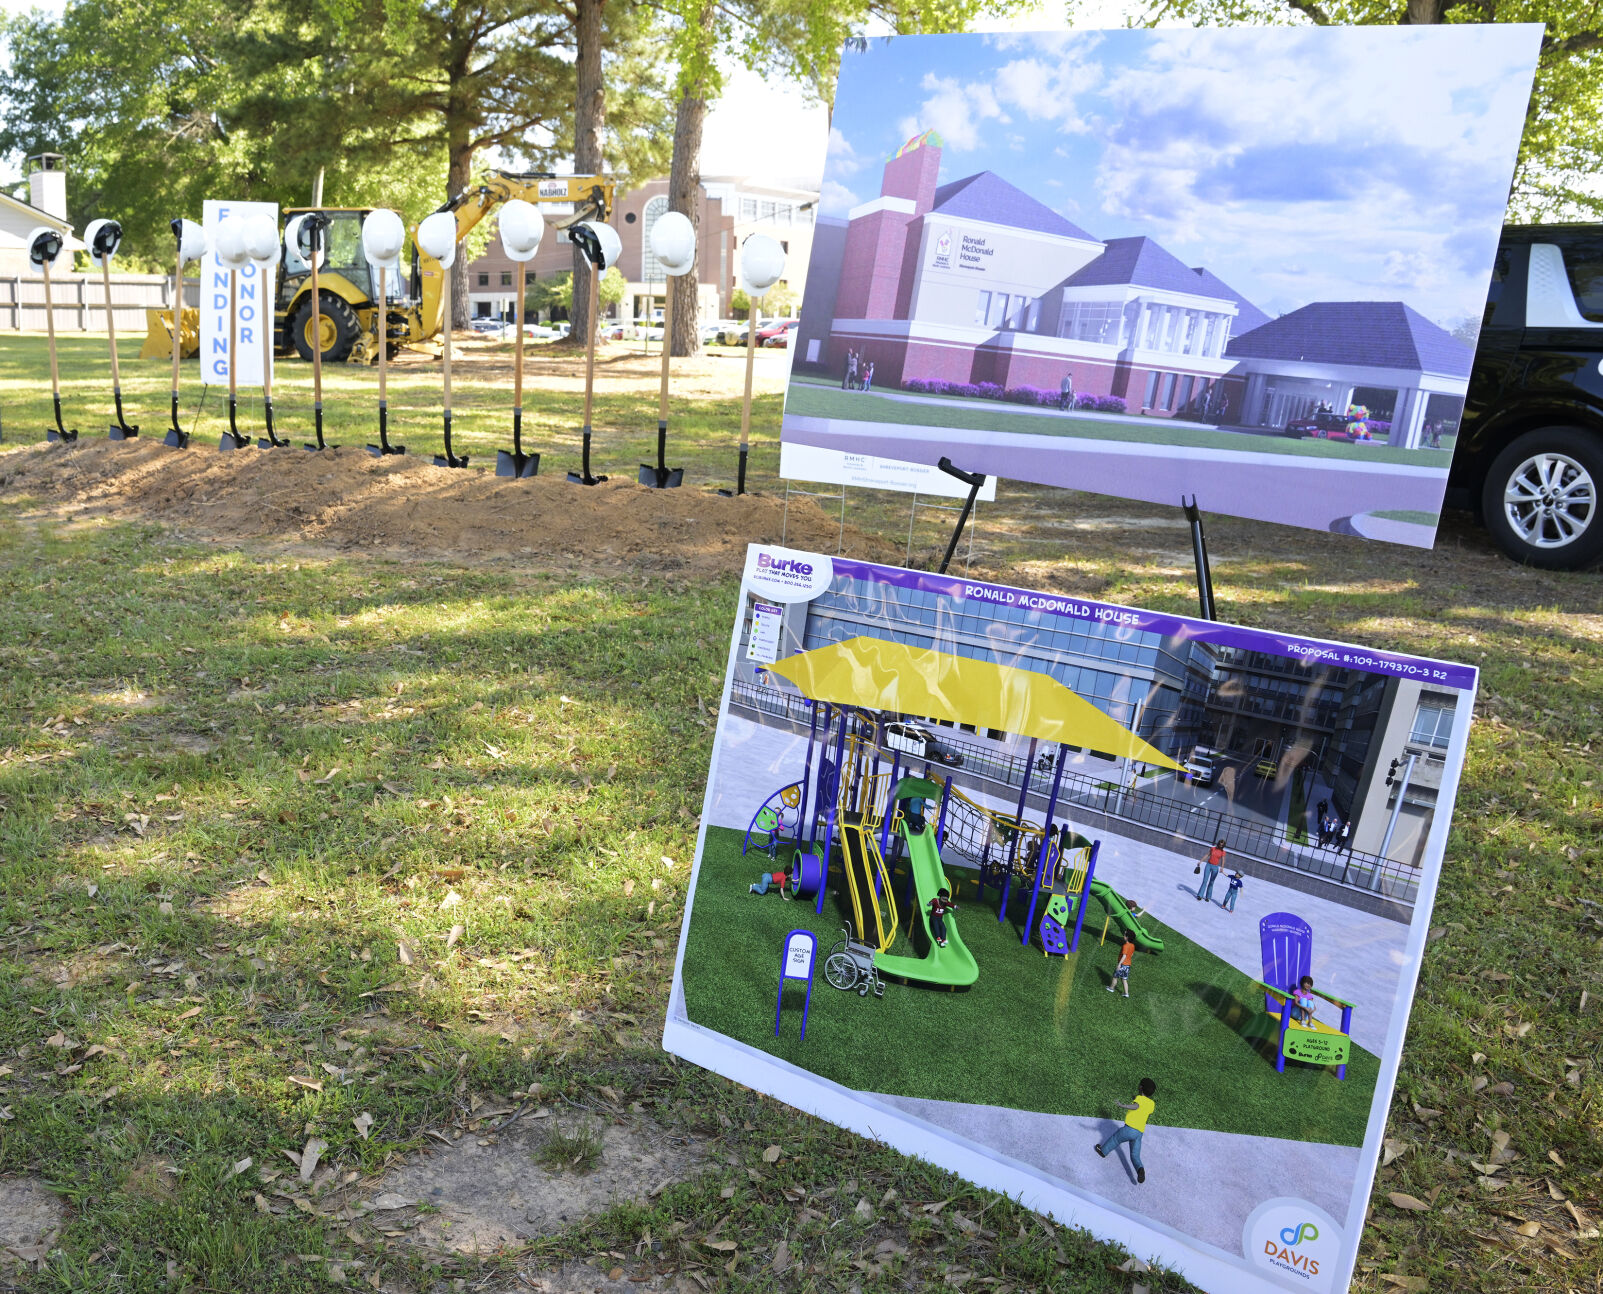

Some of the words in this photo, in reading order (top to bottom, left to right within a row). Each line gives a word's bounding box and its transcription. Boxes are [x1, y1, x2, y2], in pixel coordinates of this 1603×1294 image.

[540, 188, 567, 197] NABHOLZ
[961, 244, 994, 256] McDonald
[962, 235, 986, 246] Ronald
[960, 252, 981, 262] House
[239, 263, 257, 344] ONOR
[757, 552, 813, 576] Burke
[781, 572, 800, 580] MOVES
[965, 585, 1015, 603] RONALD
[1018, 595, 1091, 617] MCDONALD
[1094, 608, 1140, 625] HOUSE
[1287, 644, 1340, 662] PROPOSAL
[1432, 669, 1448, 680] R2
[1264, 1240, 1320, 1275] DAVIS
[1269, 1258, 1310, 1280] PLAYGROUNDS
